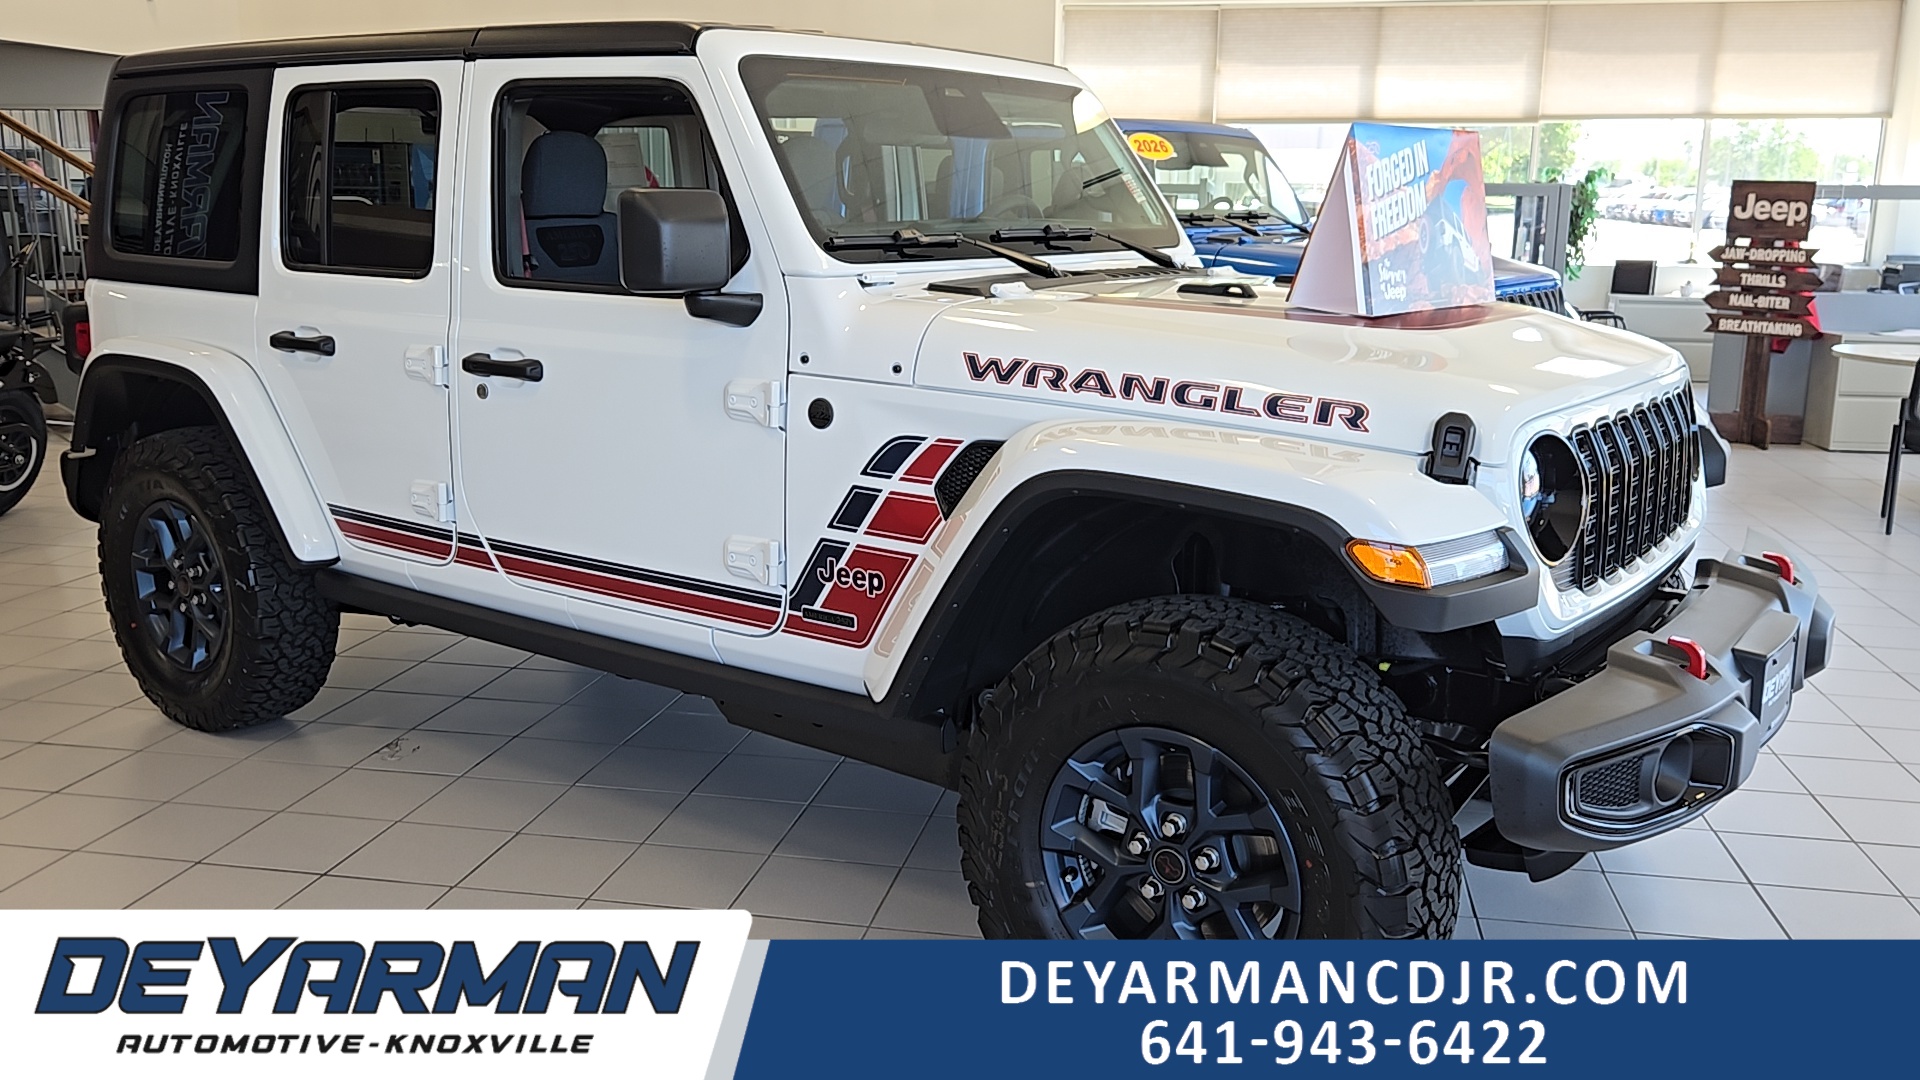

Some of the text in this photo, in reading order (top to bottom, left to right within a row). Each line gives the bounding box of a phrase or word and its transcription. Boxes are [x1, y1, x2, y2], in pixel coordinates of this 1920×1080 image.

[1133, 139, 1169, 153] 2026
[1366, 139, 1430, 201] FORGED IN
[1370, 181, 1428, 241] FREEDOM
[1733, 193, 1808, 227] Jeep
[1720, 246, 1806, 263] JAW-DROPPING
[1739, 273, 1787, 288] THRILLS
[1384, 283, 1407, 301] Jeep
[1728, 293, 1790, 310] NAIL-BITER
[1718, 318, 1803, 336] BREATHTAKING
[963, 351, 1370, 433] WRANGLER
[816, 557, 886, 598] Jeep
